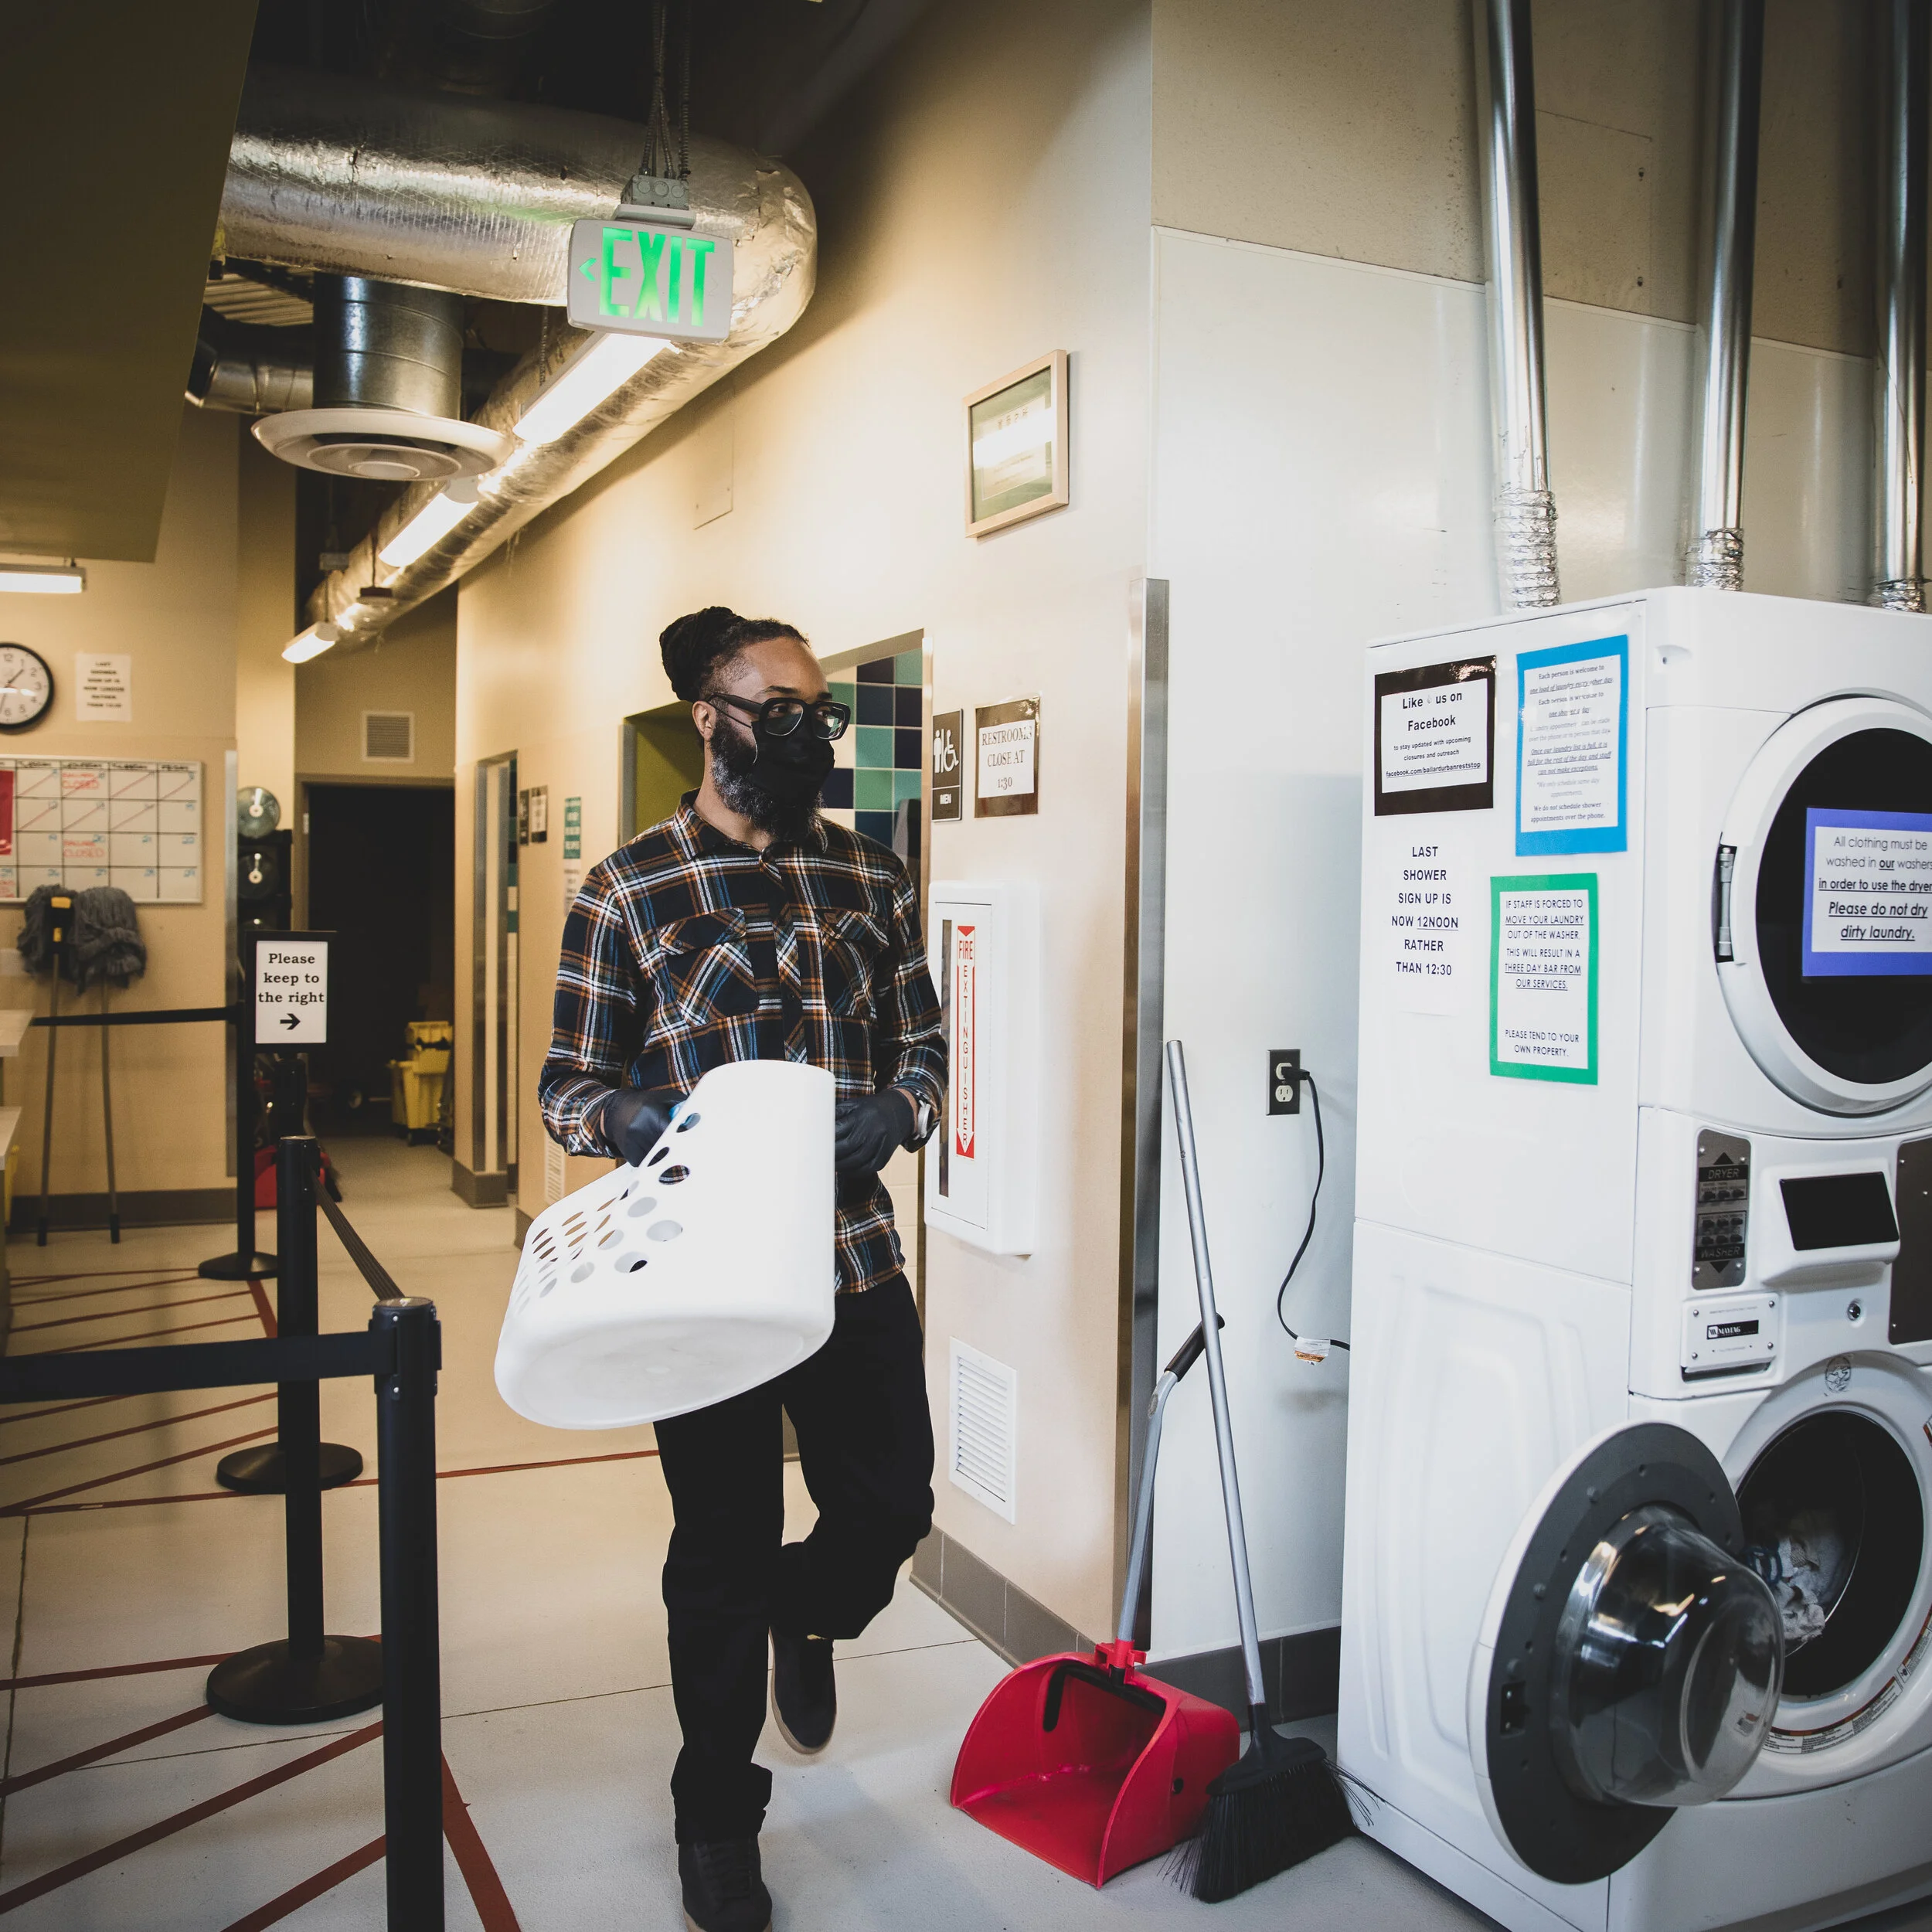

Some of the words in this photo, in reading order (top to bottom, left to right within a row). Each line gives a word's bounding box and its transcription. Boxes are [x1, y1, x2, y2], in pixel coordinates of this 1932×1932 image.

[599, 227, 715, 326] EXIT
[30, 667, 37, 677] 2
[1403, 698, 1423, 709] Like
[1436, 695, 1447, 704] us
[1451, 692, 1462, 702] on
[1407, 715, 1456, 732] Facebook
[1446, 736, 1471, 744] upcoming
[987, 752, 1012, 767] CLOSE
[1013, 750, 1026, 764] AT
[998, 777, 1013, 791] 1:30
[940, 794, 952, 804] MEN
[1531, 815, 1564, 824] appointments
[1834, 836, 1845, 847] All
[1848, 837, 1888, 852] clothing
[1891, 839, 1913, 850] must
[1916, 840, 1927, 851] be
[1412, 846, 1438, 857] LAST
[1826, 856, 1866, 868] washed
[1869, 856, 1876, 868] in
[1879, 859, 1894, 869] our
[1403, 869, 1447, 881] SHOWER
[1818, 877, 1827, 889] in
[1830, 879, 1856, 889] order
[1859, 879, 1869, 889] to
[1871, 882, 1888, 890] use
[1891, 879, 1906, 891] the
[1398, 893, 1421, 904] SIGN
[1425, 893, 1438, 904] UP
[1442, 893, 1451, 904] IS
[1513, 900, 1532, 909] STAFF
[1534, 900, 1540, 909] IS
[1543, 900, 1571, 908] FORCED
[1573, 899, 1583, 908] TO
[1828, 901, 1867, 915] Please
[1871, 903, 1886, 916] do
[1889, 903, 1908, 916] not
[1910, 903, 1928, 918] dry
[1391, 916, 1414, 927] NOW
[1417, 917, 1459, 928] 12NOON
[1505, 915, 1526, 924] MOVE
[1529, 915, 1548, 924] YOUR
[1550, 915, 1584, 924] LAUNDRY
[1507, 930, 1521, 939] OUT
[1523, 930, 1532, 939] OF
[1535, 930, 1546, 939] THE
[1841, 925, 1866, 940] dirty
[1869, 926, 1915, 940] laundry.
[958, 940, 973, 960] FIRE
[1404, 939, 1444, 951] RATHER
[268, 953, 315, 964] Please
[1506, 948, 1520, 957] THIS
[1522, 948, 1537, 957] WILL
[1539, 949, 1563, 957] RESULT
[1565, 949, 1573, 957] IN
[1575, 949, 1580, 957] A
[1396, 961, 1422, 974] THAN
[1426, 963, 1452, 975] 12:30
[1505, 963, 1524, 972] THREE
[1526, 964, 1542, 973] DAY
[1544, 964, 1558, 973] BAR
[1560, 964, 1581, 974] FROM
[263, 972, 299, 986] keep
[304, 974, 320, 984] to
[1515, 978, 1531, 988] OUR
[1533, 979, 1568, 989] SERVICES.
[258, 992, 283, 1002] the
[288, 992, 325, 1005] right
[1505, 1029, 1527, 1039] PLEASE
[1529, 1031, 1546, 1040] TEND
[1548, 1032, 1557, 1041] TO
[1560, 1033, 1580, 1043] YOUR
[1514, 1044, 1531, 1054] OWN
[1533, 1046, 1570, 1057] PROPERTY.
[1708, 1168, 1740, 1179] DRYER
[1701, 1247, 1740, 1258] WASHER
